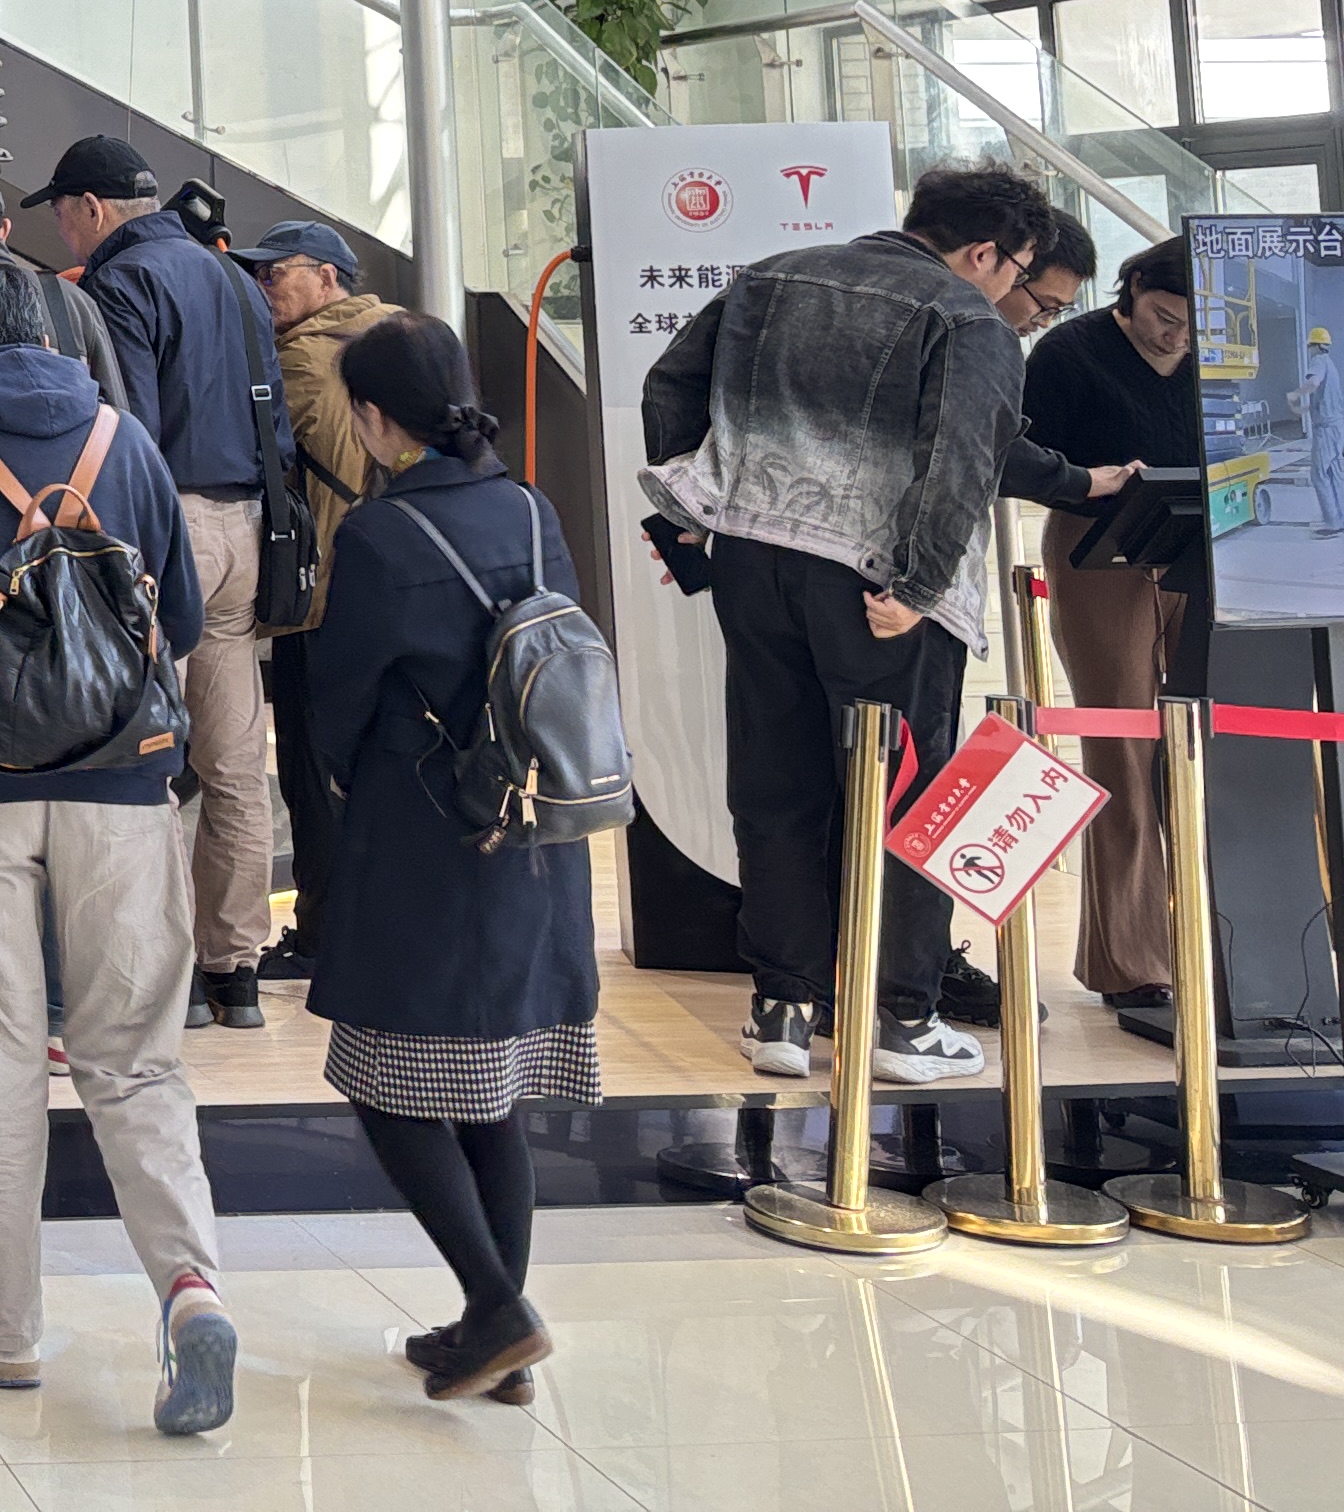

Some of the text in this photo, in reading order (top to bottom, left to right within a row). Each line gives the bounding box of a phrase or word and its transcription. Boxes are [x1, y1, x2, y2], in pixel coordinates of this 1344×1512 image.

[779, 222, 834, 231] TESLA
[1195, 224, 1343, 258] 地面展示台
[987, 766, 1069, 854] 请勿入内
